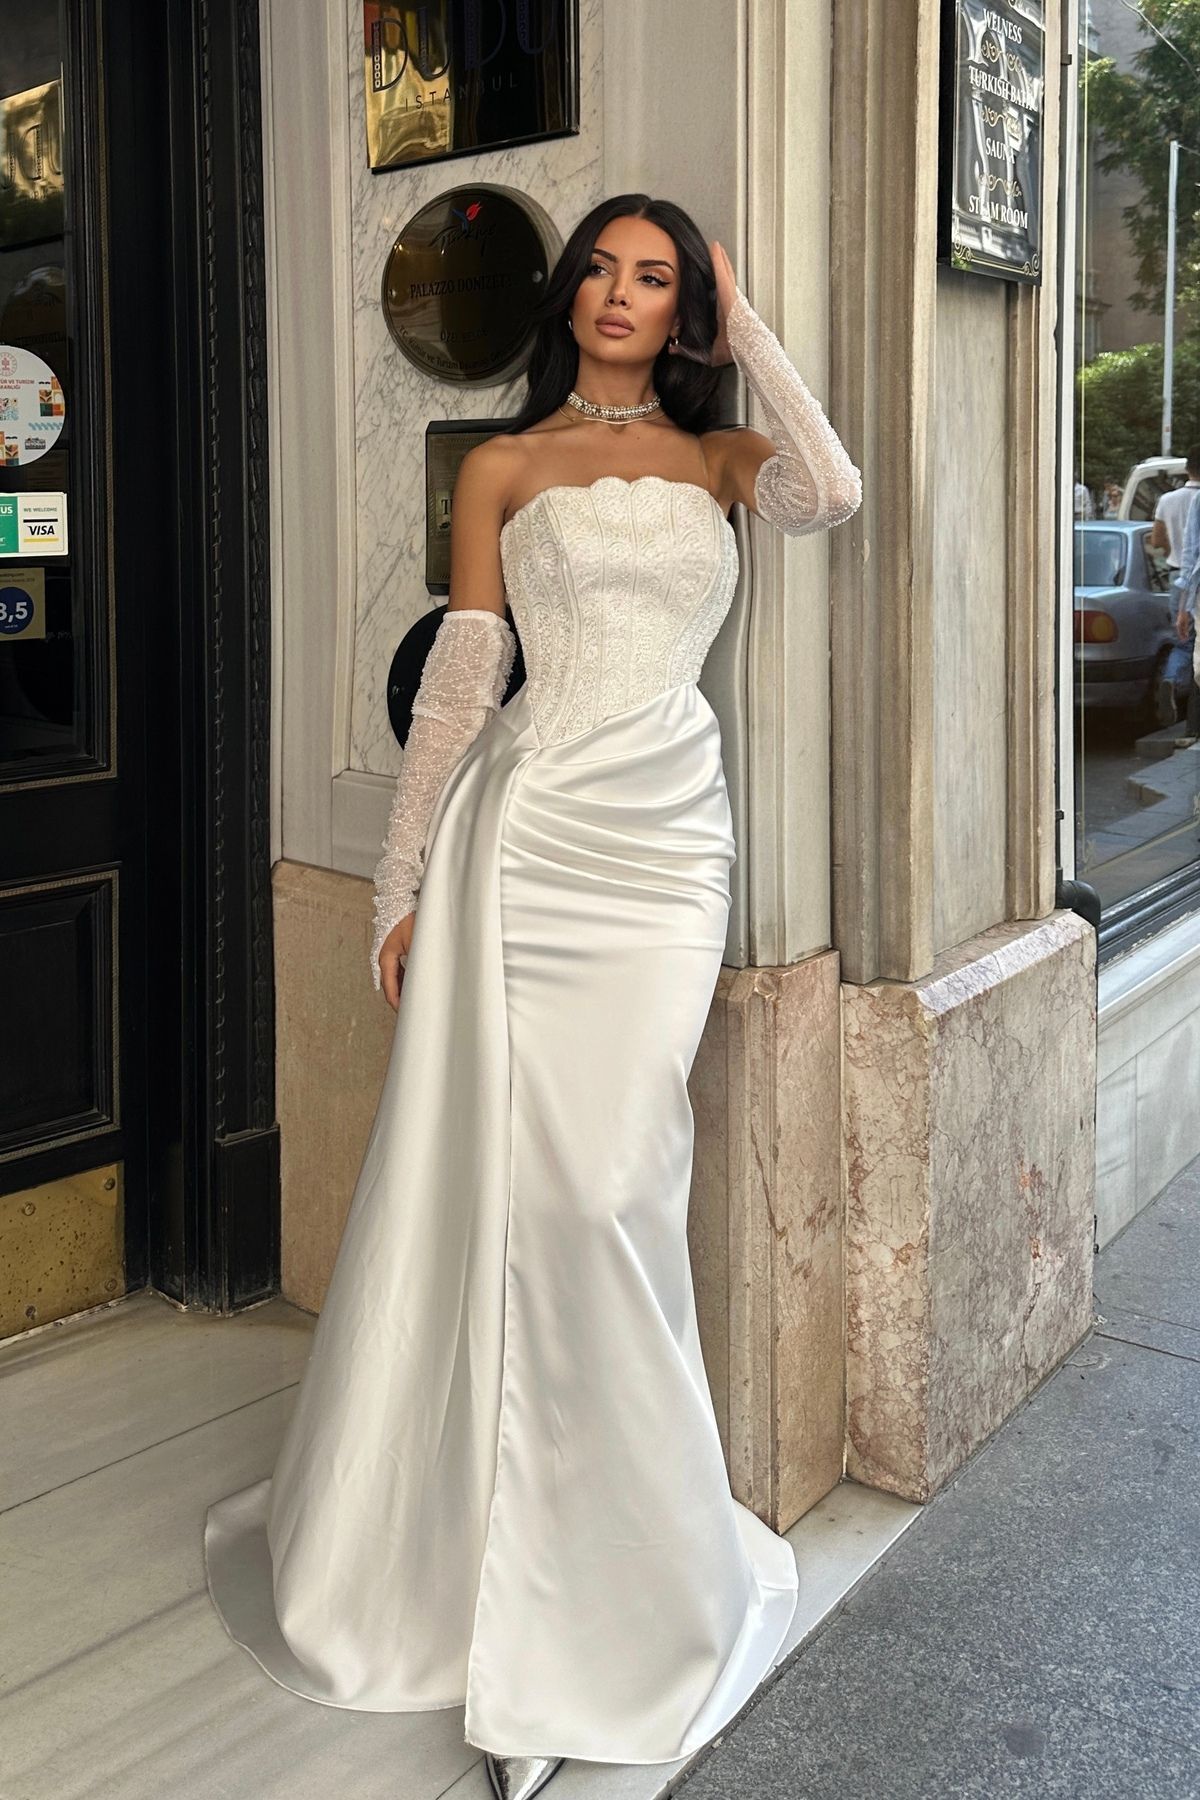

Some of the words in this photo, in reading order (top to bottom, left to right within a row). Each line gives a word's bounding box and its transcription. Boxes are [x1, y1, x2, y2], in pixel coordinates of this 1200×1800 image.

[982, 8, 1023, 44] WELNESS
[968, 65, 1010, 100] TURKISH
[985, 137, 1015, 164] SAUNA
[969, 195, 998, 220] STEAM
[1001, 203, 1028, 229] ROOM
[410, 279, 454, 299] PALAZZO
[28, 525, 55, 536] VISA
